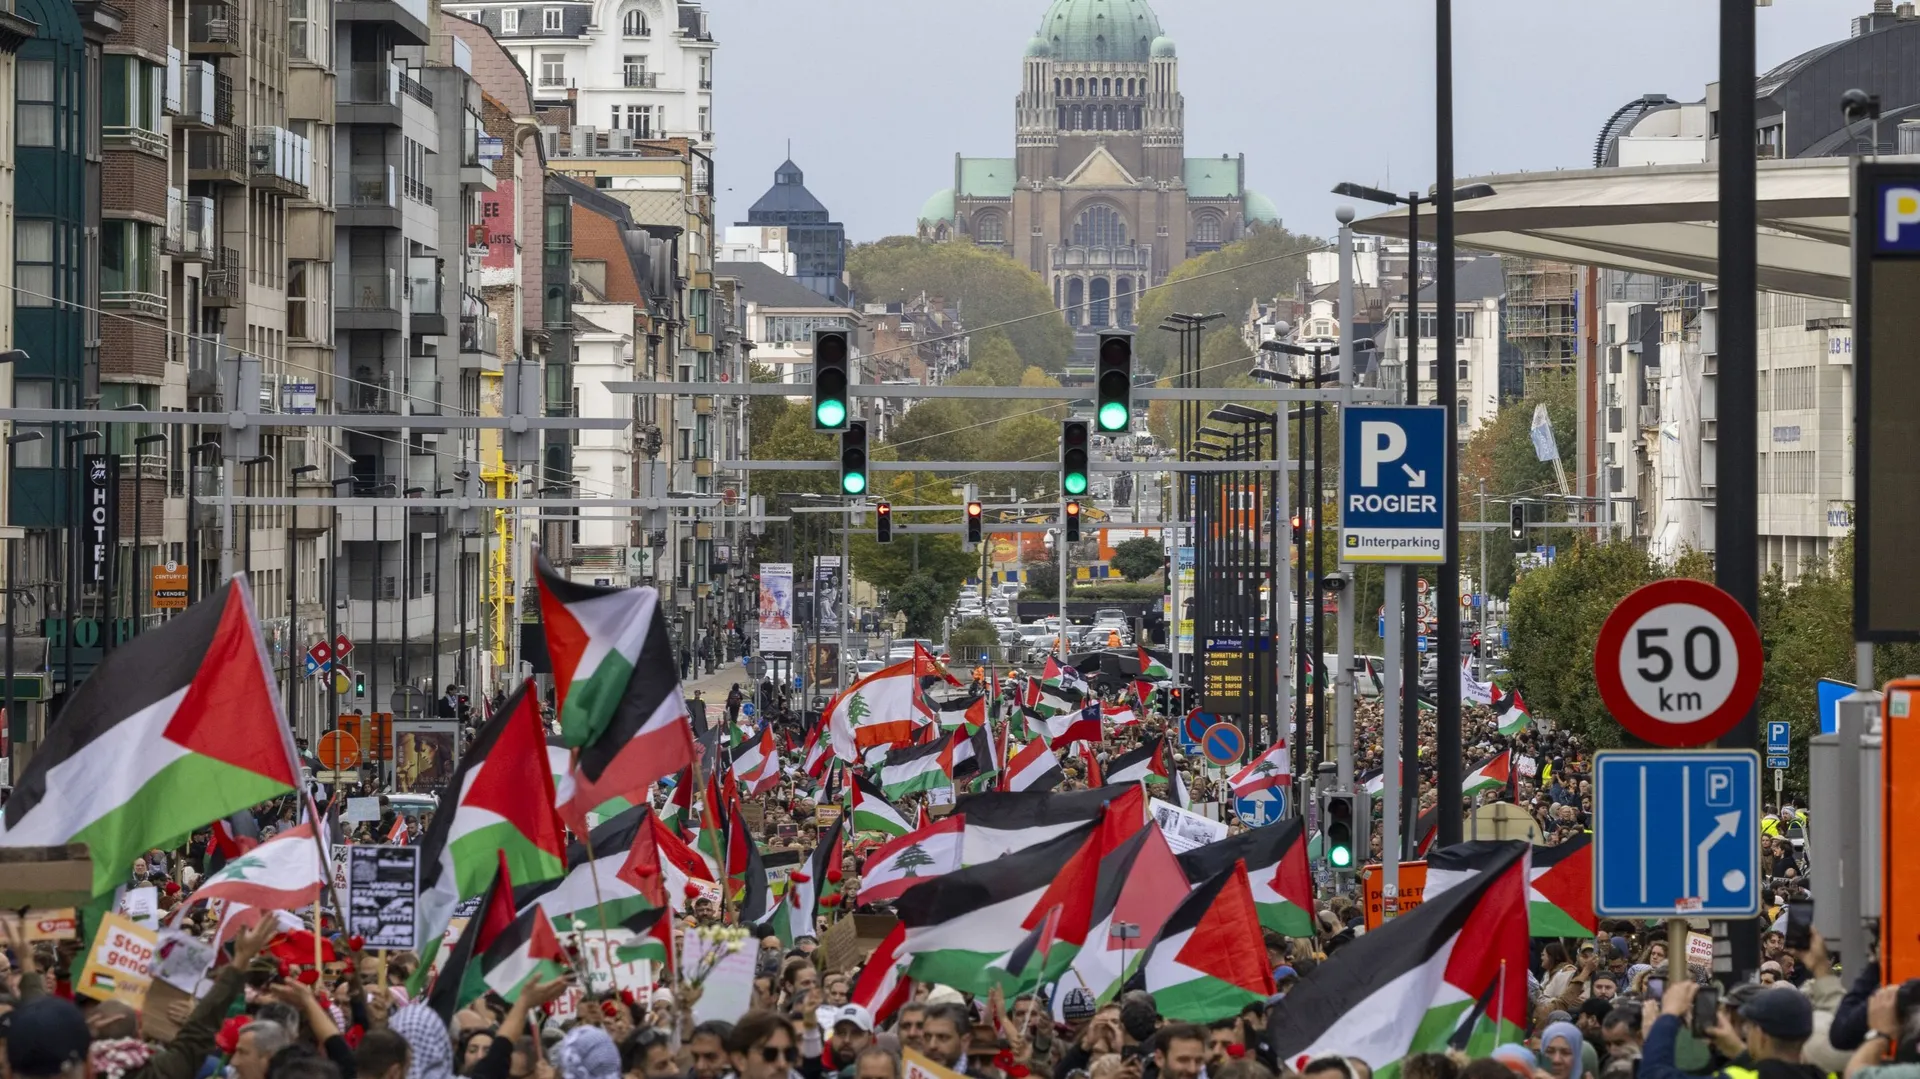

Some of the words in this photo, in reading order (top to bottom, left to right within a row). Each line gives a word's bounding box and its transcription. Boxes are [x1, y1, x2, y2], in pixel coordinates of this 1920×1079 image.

[481, 202, 499, 218] EE
[489, 234, 512, 244] LISTS
[1361, 421, 1407, 487] P
[1350, 495, 1437, 513] ROGIER
[92, 488, 106, 581] HOTEL
[1361, 536, 1440, 549] Interparking
[1636, 626, 1721, 683] 50
[1659, 687, 1701, 712] km
[1772, 724, 1785, 741] P
[1710, 773, 1729, 800] P
[354, 848, 377, 857] THE
[352, 890, 398, 898] STANDS
[369, 882, 413, 891] WORLD
[380, 914, 412, 922] WITH
[113, 933, 153, 960] Stop
[367, 936, 412, 946] LESTINE
[1692, 938, 1712, 950] Stop
[1690, 946, 1712, 956] geno
[107, 950, 155, 977] geno
